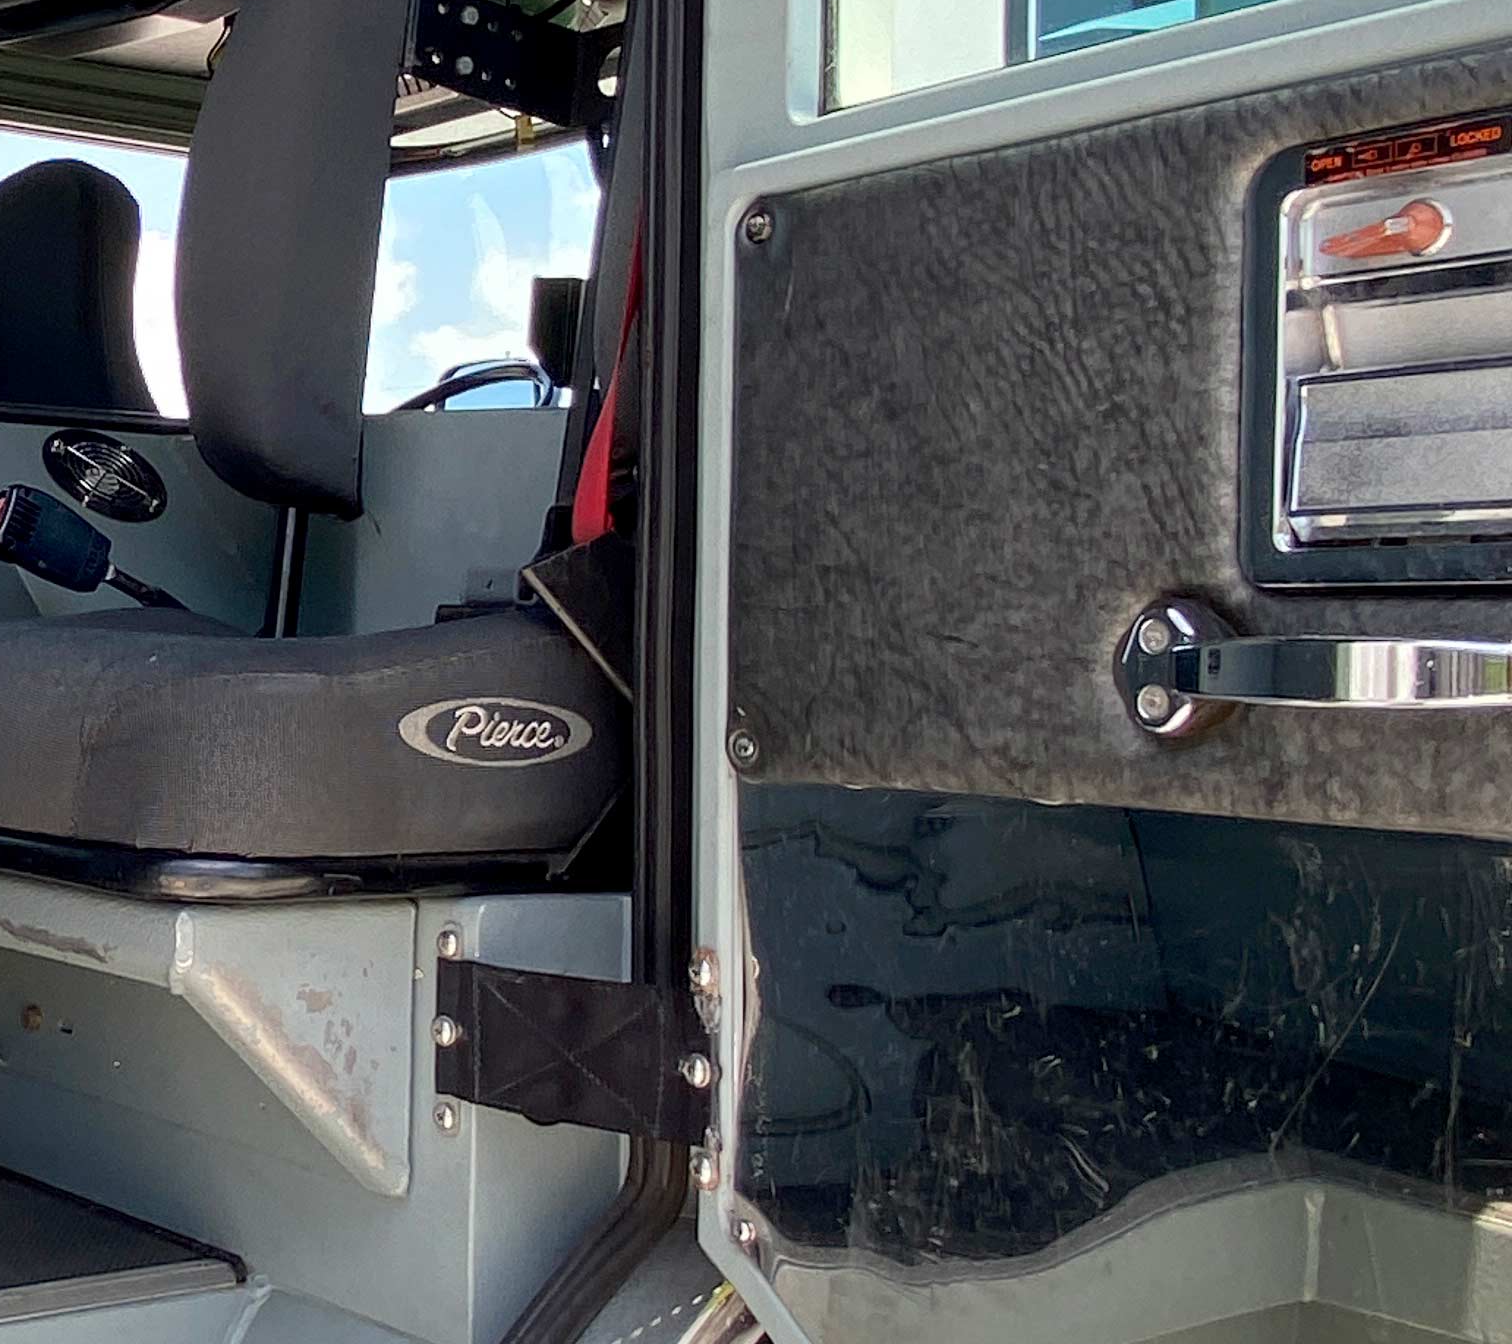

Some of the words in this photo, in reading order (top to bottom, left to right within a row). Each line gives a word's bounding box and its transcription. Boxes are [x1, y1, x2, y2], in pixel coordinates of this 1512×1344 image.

[1310, 155, 1343, 172] OPEN
[1449, 125, 1502, 147] LOCKED
[445, 705, 555, 752] Pierce
